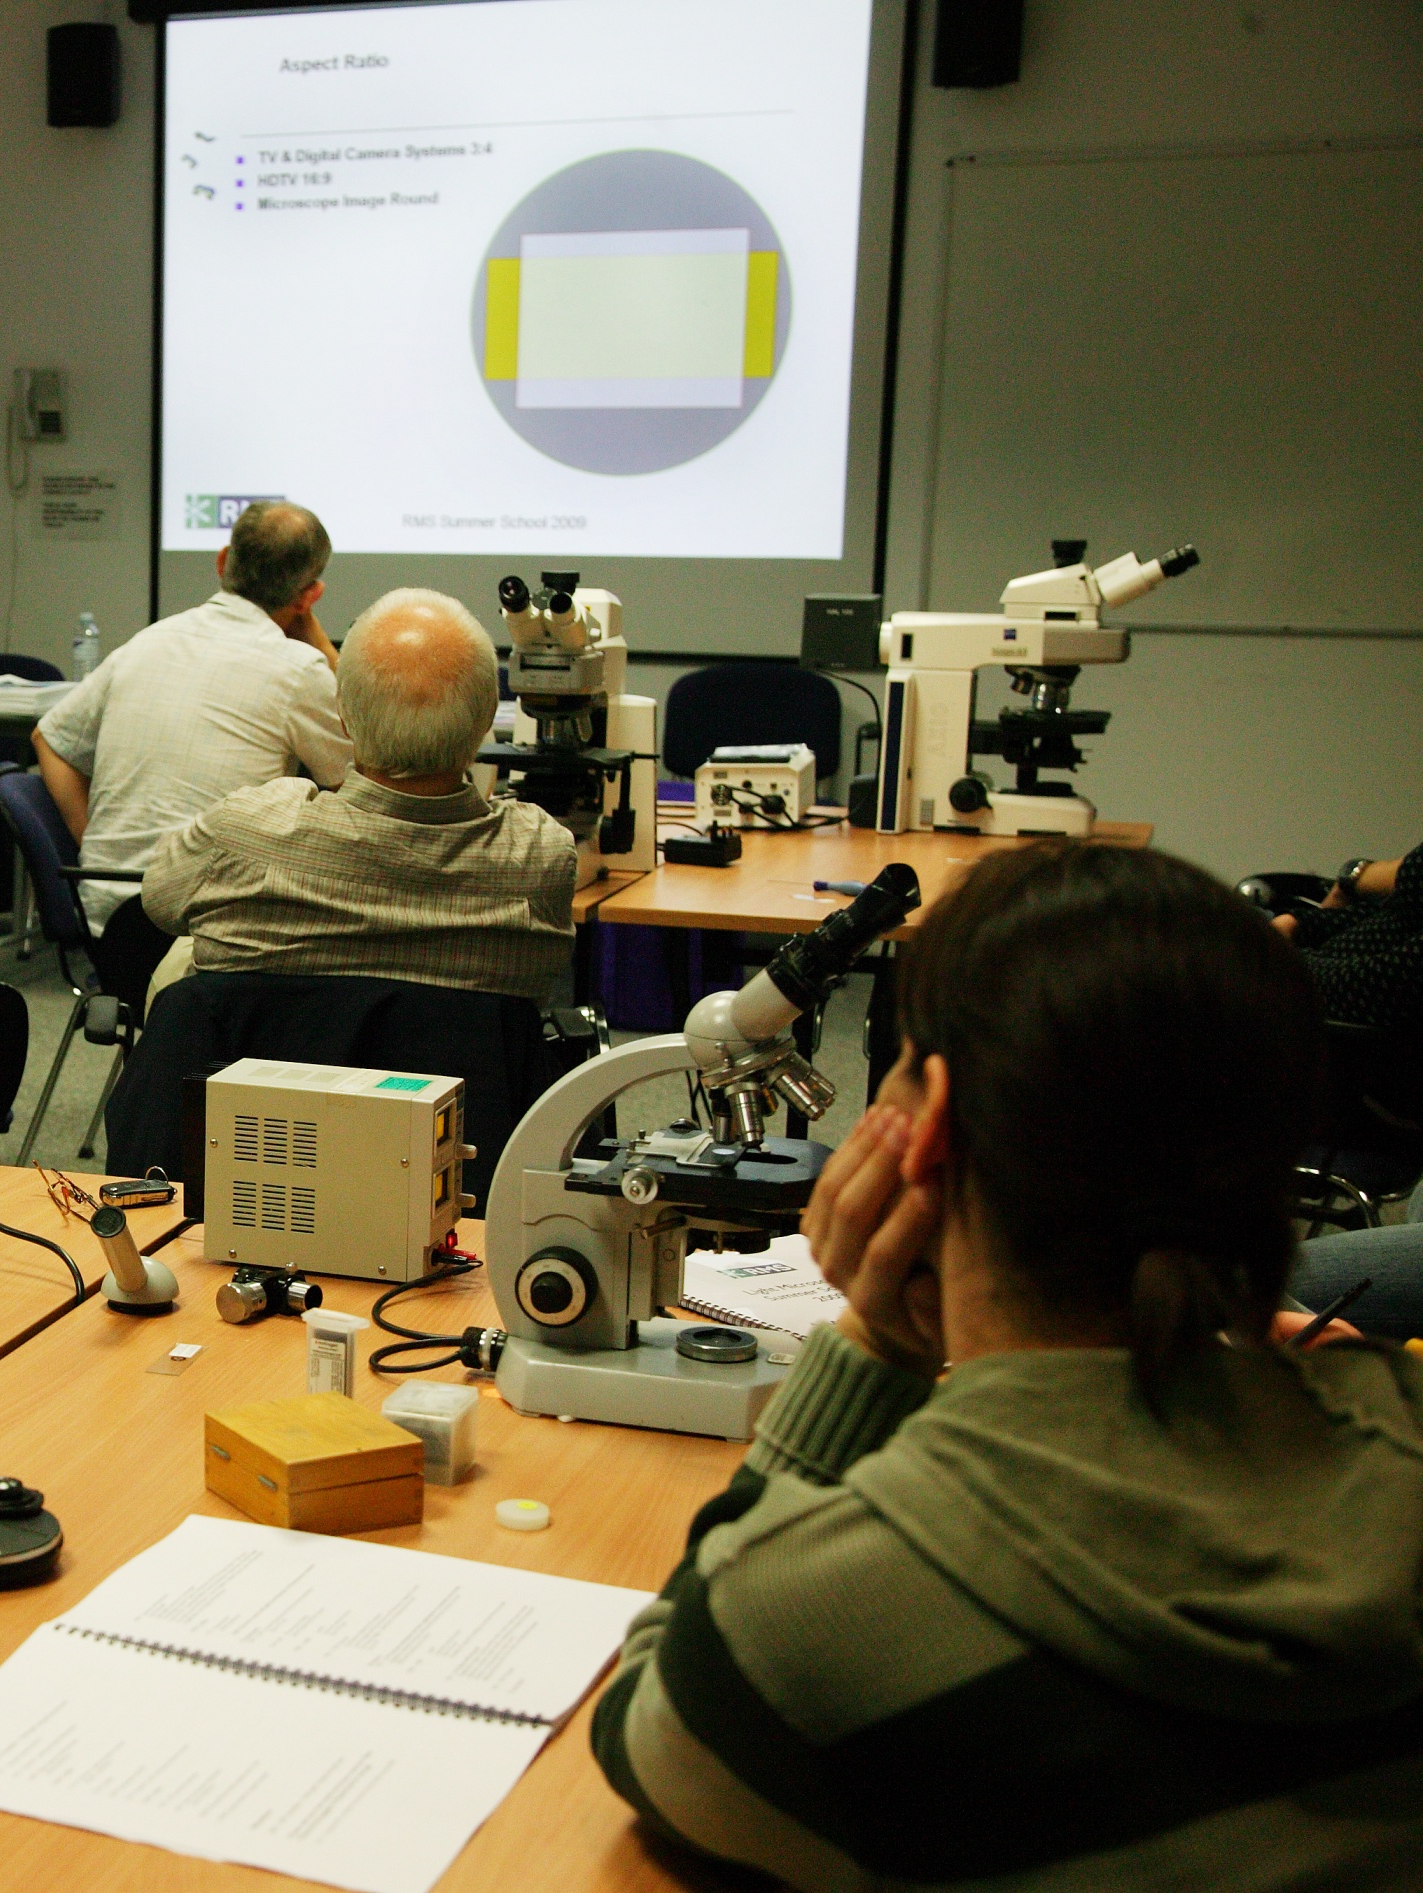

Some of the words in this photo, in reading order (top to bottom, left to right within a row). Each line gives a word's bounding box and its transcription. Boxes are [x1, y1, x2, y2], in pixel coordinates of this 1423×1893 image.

[280, 57, 338, 75] Aspect
[344, 54, 389, 69] Ratio
[258, 151, 277, 164] TV
[281, 150, 292, 163] &
[295, 148, 341, 165] Digital
[345, 146, 400, 161] Camera
[405, 143, 466, 161] Systems
[257, 173, 298, 187] HDTV
[257, 197, 339, 211] Microscope
[342, 194, 386, 210] Image
[390, 191, 439, 206] Round
[402, 514, 437, 529] RMS
[440, 514, 496, 529] Summer
[500, 514, 548, 529] School
[744, 1263, 790, 1277] RMS
